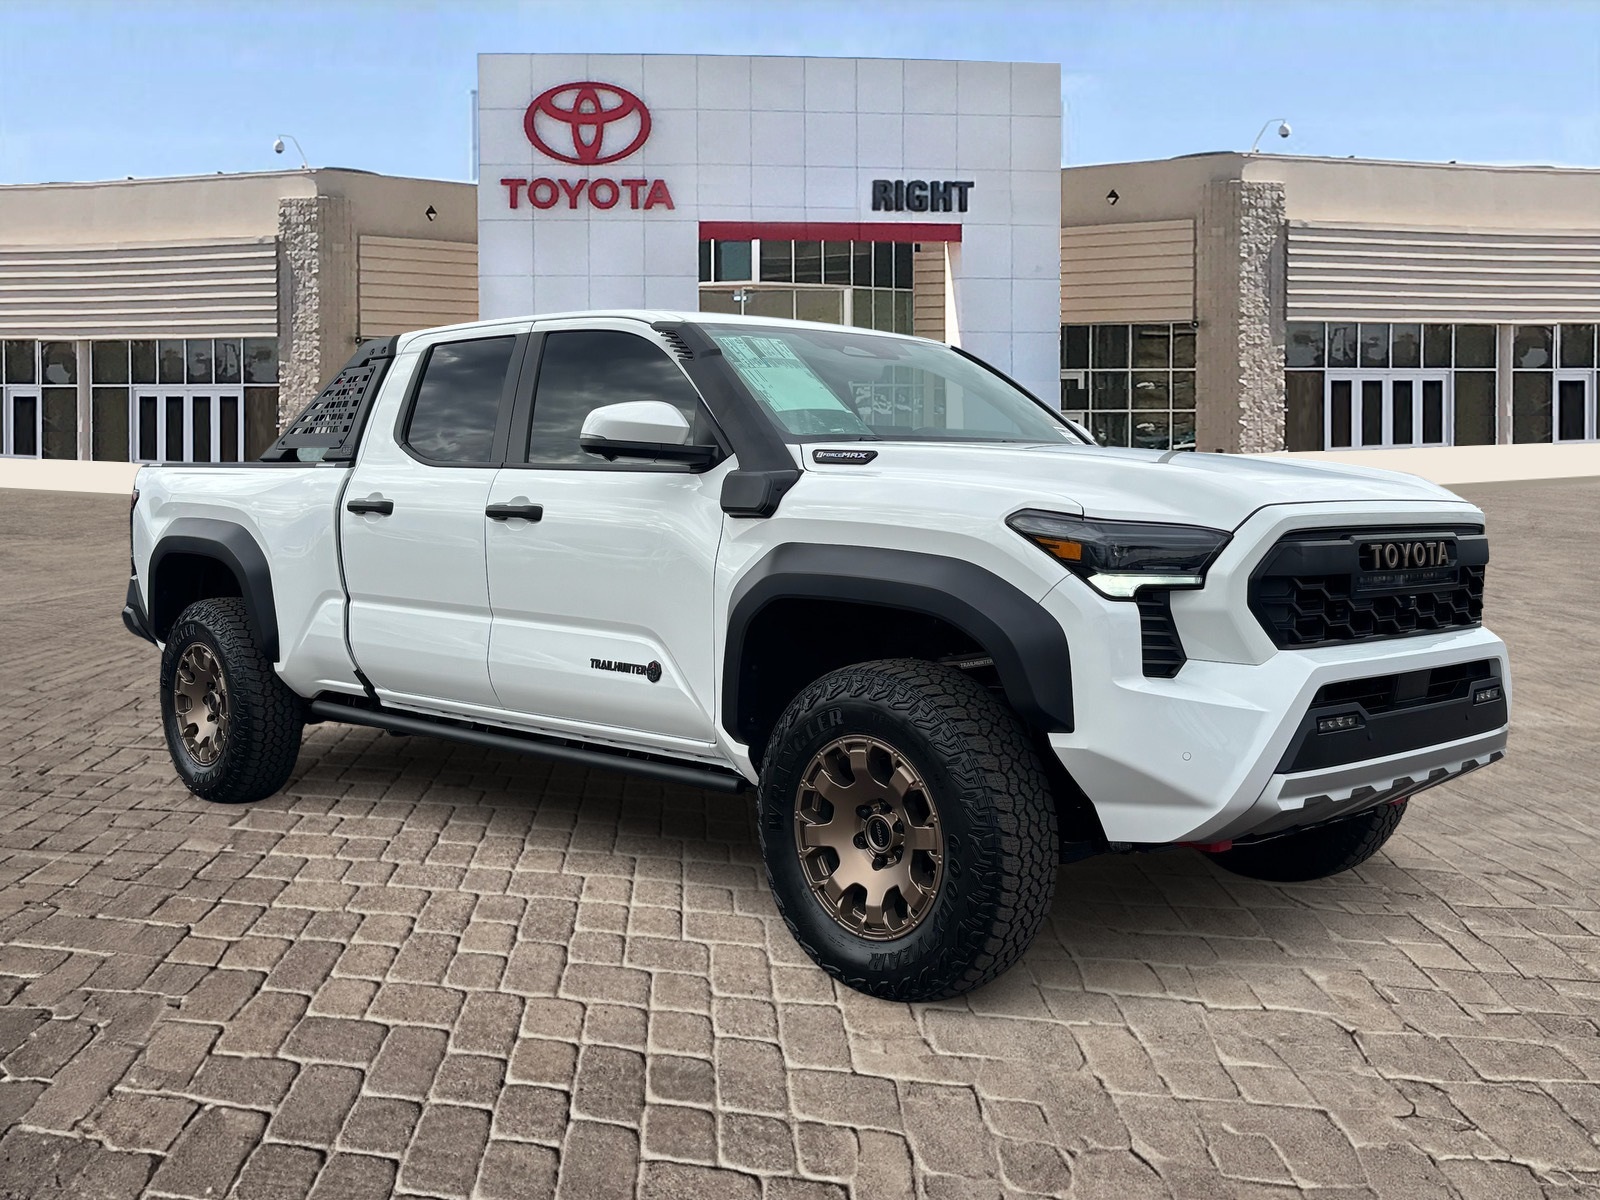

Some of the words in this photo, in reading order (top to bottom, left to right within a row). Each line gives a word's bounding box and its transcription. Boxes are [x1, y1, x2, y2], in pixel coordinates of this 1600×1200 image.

[500, 178, 676, 210] TOYOTA
[872, 180, 975, 212] RIGHT
[1370, 541, 1449, 569] TOYOTA
[590, 658, 647, 676] TRAILHUNTER
